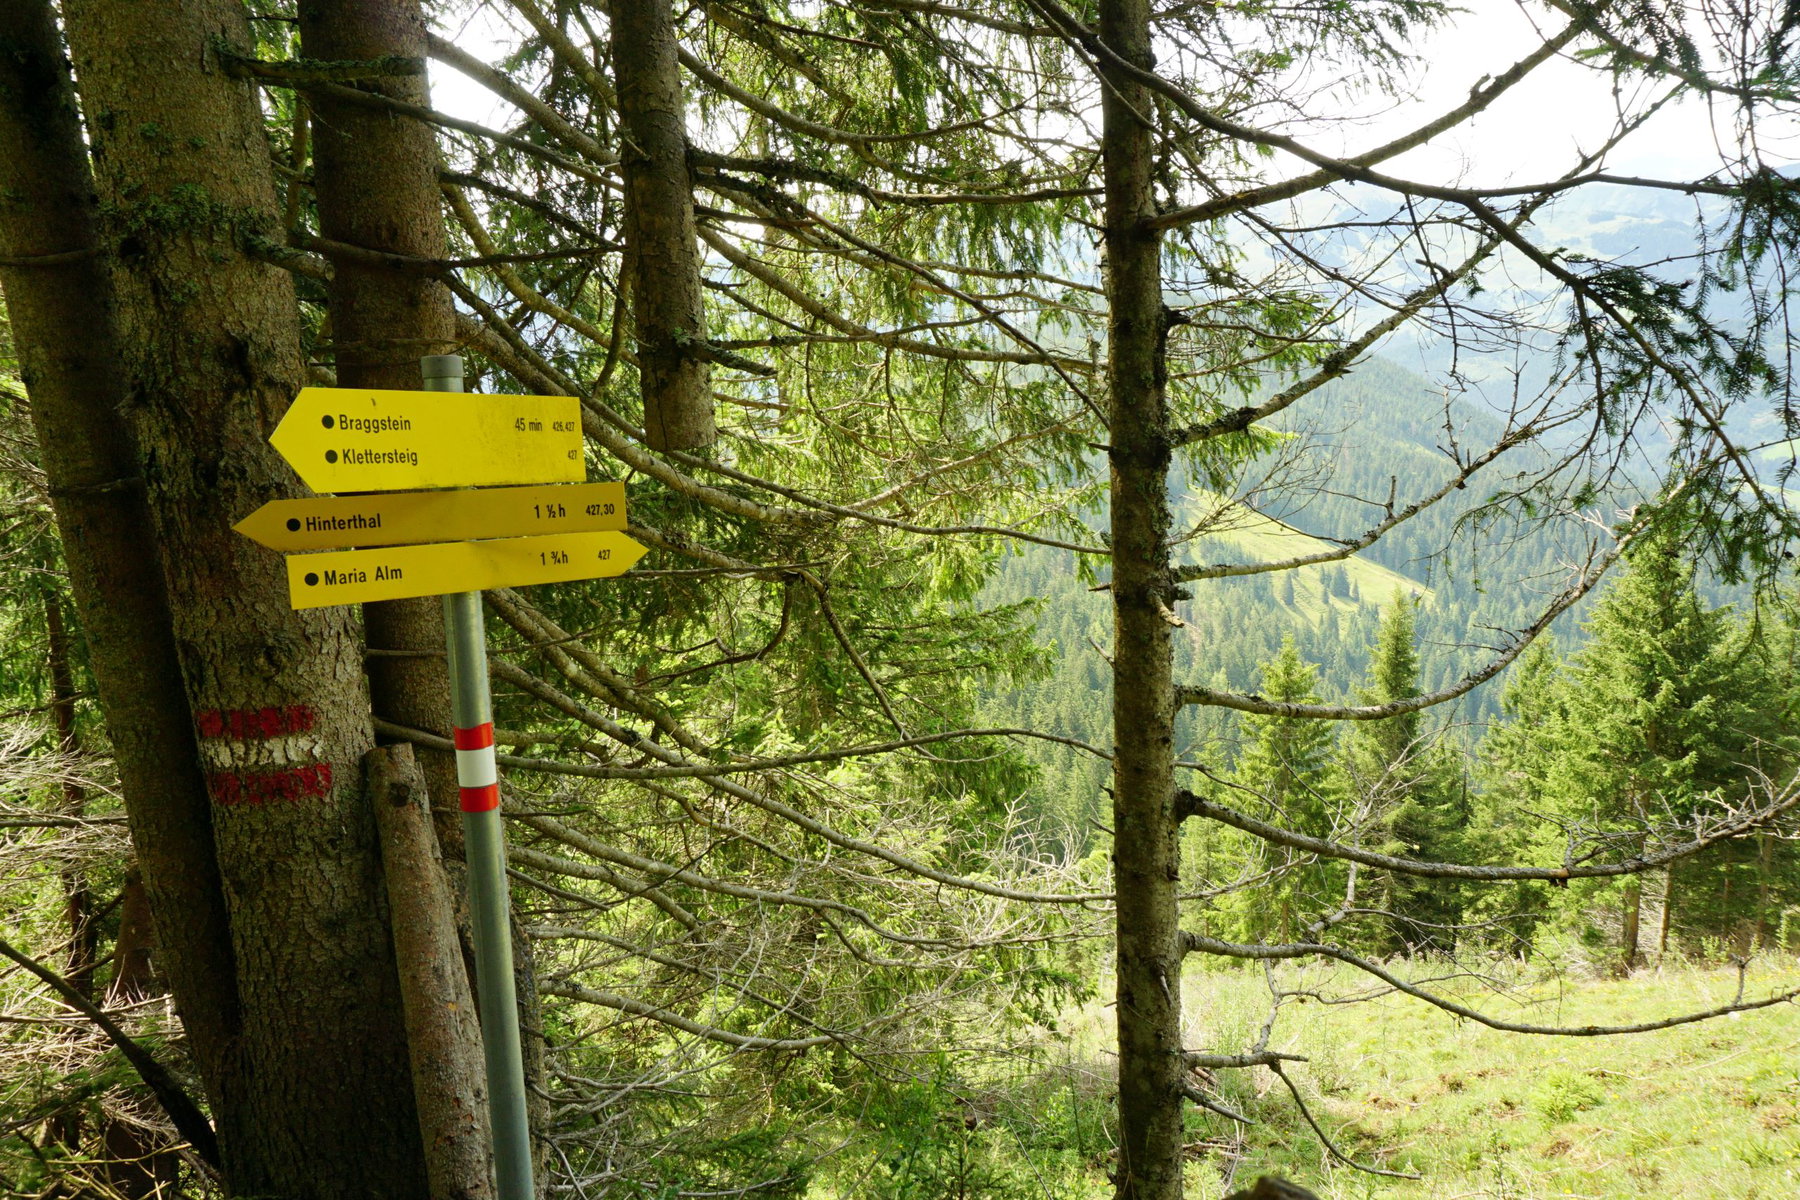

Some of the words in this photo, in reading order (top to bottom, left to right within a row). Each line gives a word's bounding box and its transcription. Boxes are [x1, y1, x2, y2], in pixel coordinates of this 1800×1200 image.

[339, 414, 411, 433] Braggstein
[514, 417, 526, 431] 45
[528, 418, 543, 431] min
[552, 421, 575, 432] 426,427
[342, 448, 418, 466] Klettersteig
[567, 449, 577, 460] 427
[305, 513, 382, 532] Hinterthal
[534, 504, 540, 519] 1
[585, 503, 615, 516] 427,30
[324, 568, 367, 586] Maria
[375, 565, 403, 581] Alm
[540, 552, 546, 566] 1
[597, 549, 611, 561] 427
